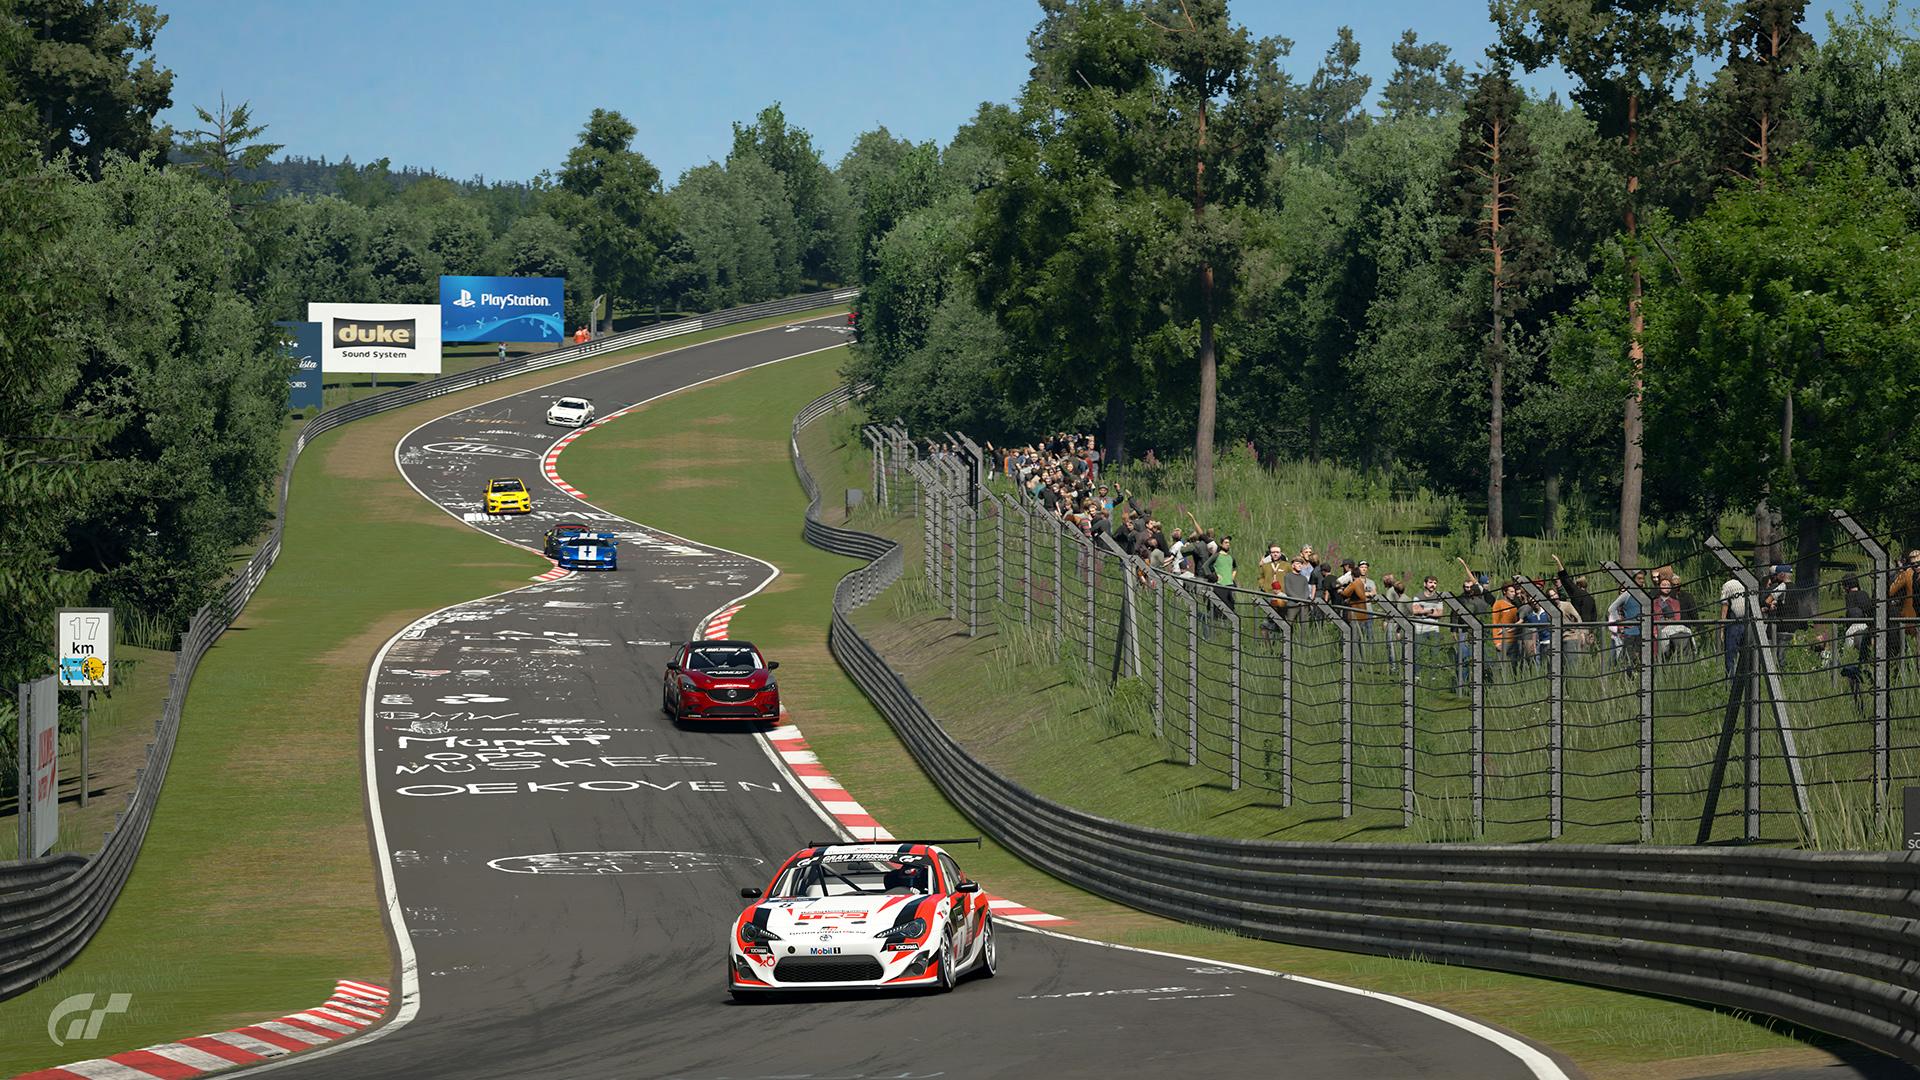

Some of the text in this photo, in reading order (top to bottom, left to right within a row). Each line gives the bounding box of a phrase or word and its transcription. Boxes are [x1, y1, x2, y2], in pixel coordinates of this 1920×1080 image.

[481, 293, 548, 310] PlayStation
[338, 324, 409, 343] duke
[342, 350, 407, 360] Sound System
[69, 616, 100, 640] 17
[72, 642, 94, 654] km
[810, 947, 833, 955] Mobil
